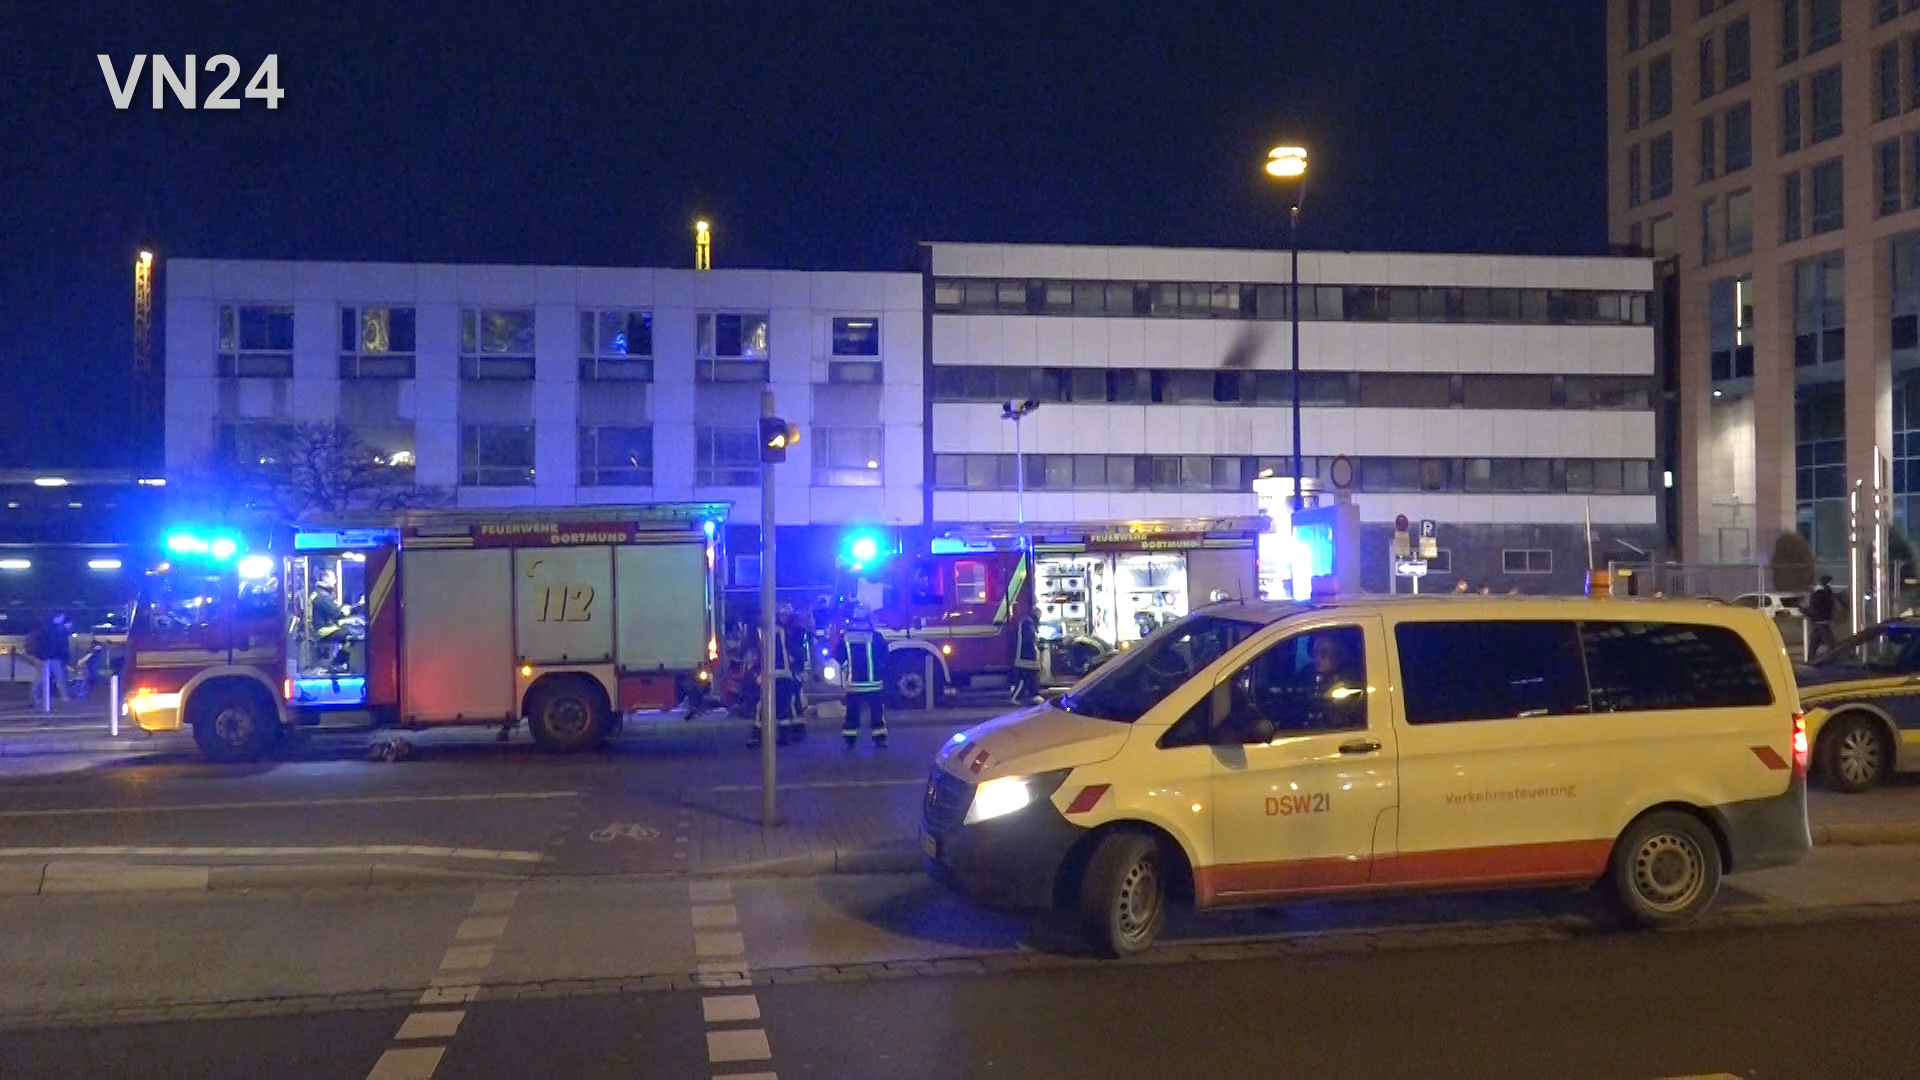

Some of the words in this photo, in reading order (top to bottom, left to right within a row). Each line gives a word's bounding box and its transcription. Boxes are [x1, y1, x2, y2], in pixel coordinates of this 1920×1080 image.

[481, 523, 559, 534] FEUERWEHR
[551, 533, 626, 544] DORTMUND
[1091, 533, 1147, 541] FEUERWEHR
[1141, 541, 1198, 549] DORTMUND
[536, 586, 595, 623] 112
[1445, 785, 1576, 804] Verkehrssteuerung
[1265, 793, 1330, 816] DSW21
